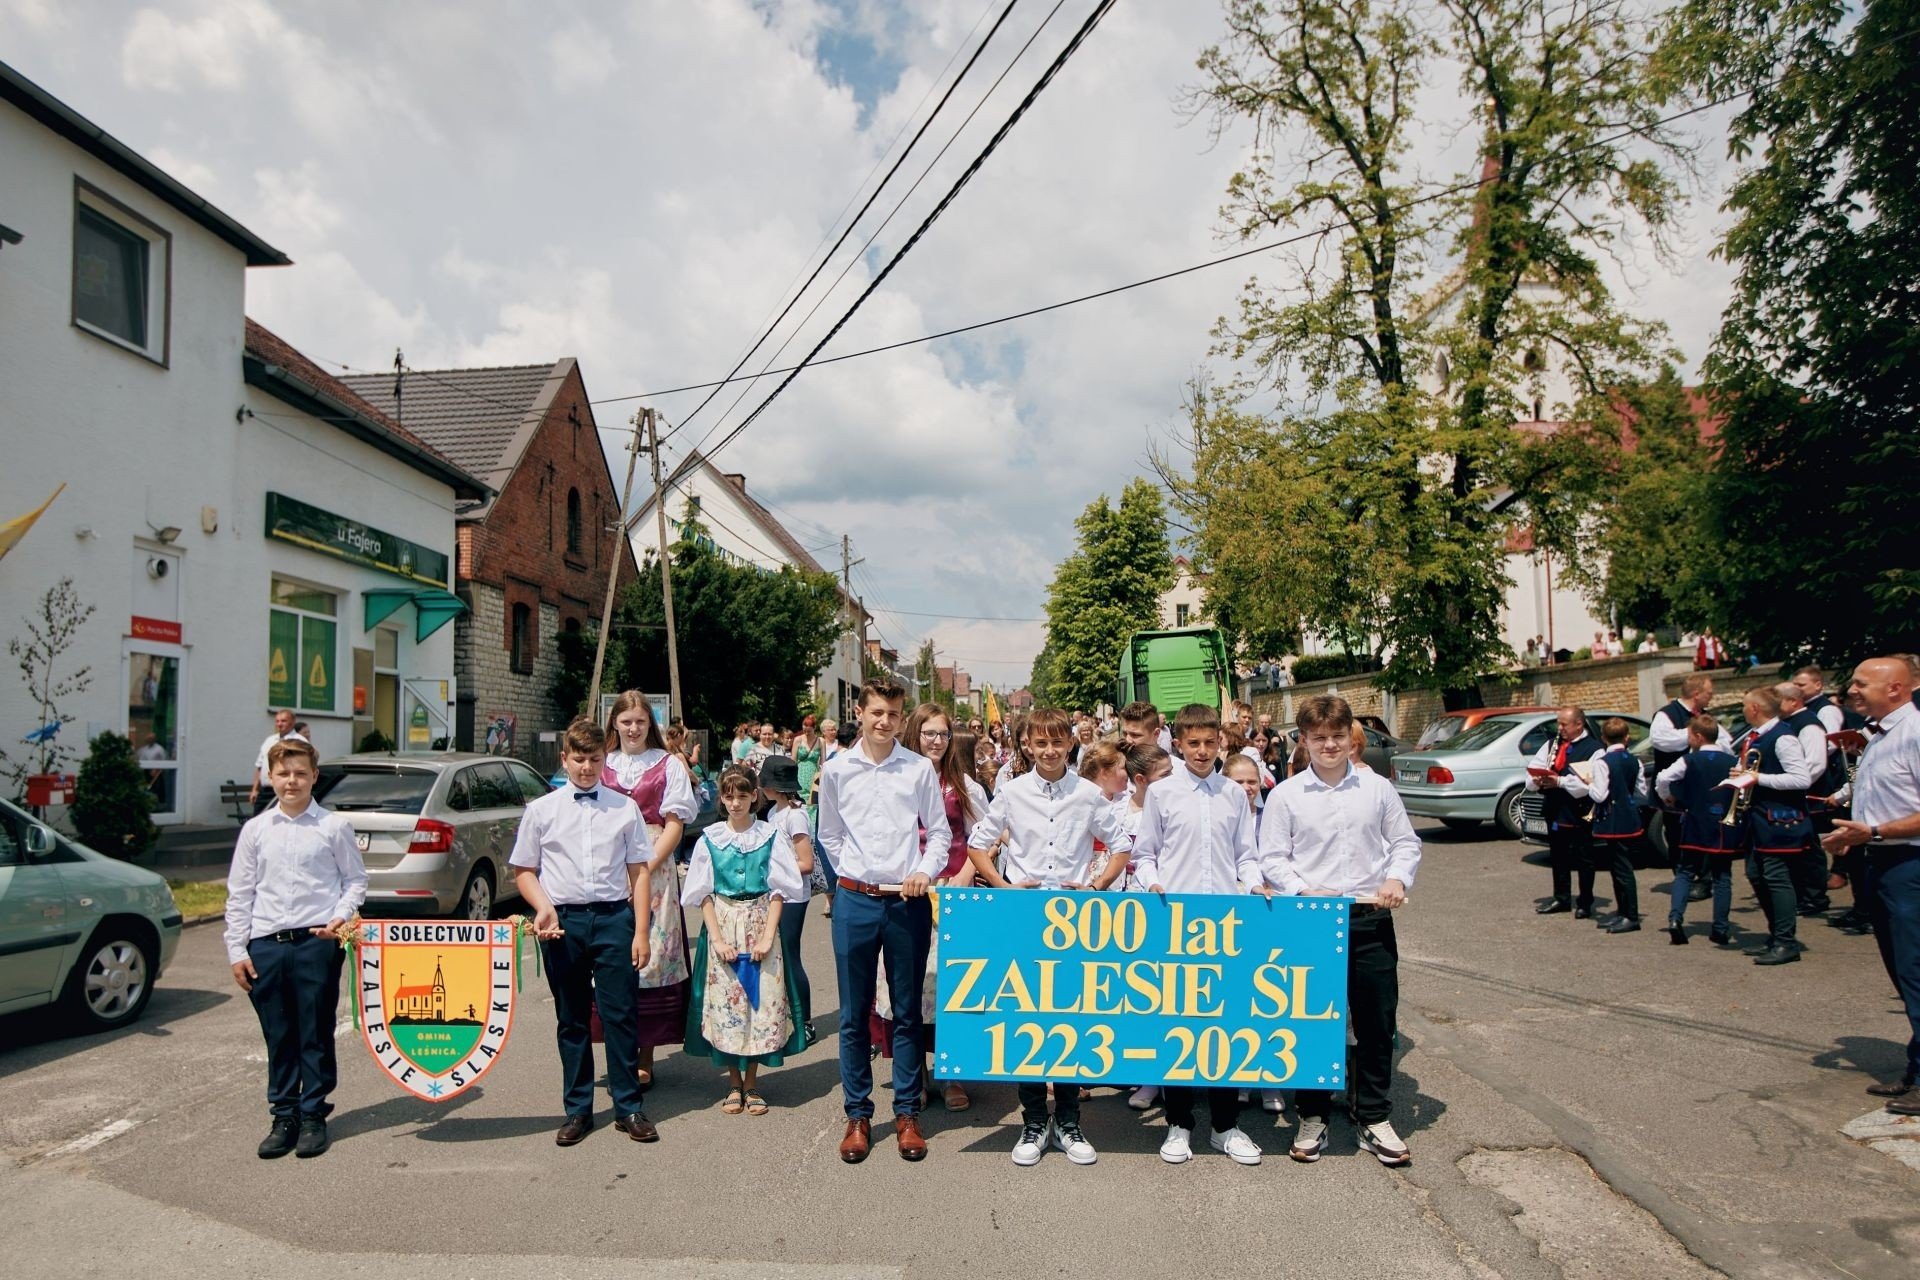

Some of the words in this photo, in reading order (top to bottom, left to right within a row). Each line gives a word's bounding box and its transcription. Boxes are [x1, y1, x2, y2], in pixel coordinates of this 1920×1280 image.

[337, 528, 345, 541] u
[348, 528, 381, 553] Fajera
[389, 925, 486, 942] SOŁECTWO
[1042, 896, 1147, 953] 800
[1166, 902, 1243, 957] lat
[944, 958, 1225, 1018] ZALESIE
[1251, 948, 1340, 1020] ŚL.
[362, 959, 416, 1083] ZALESIE
[417, 1033, 452, 1041] GMINA
